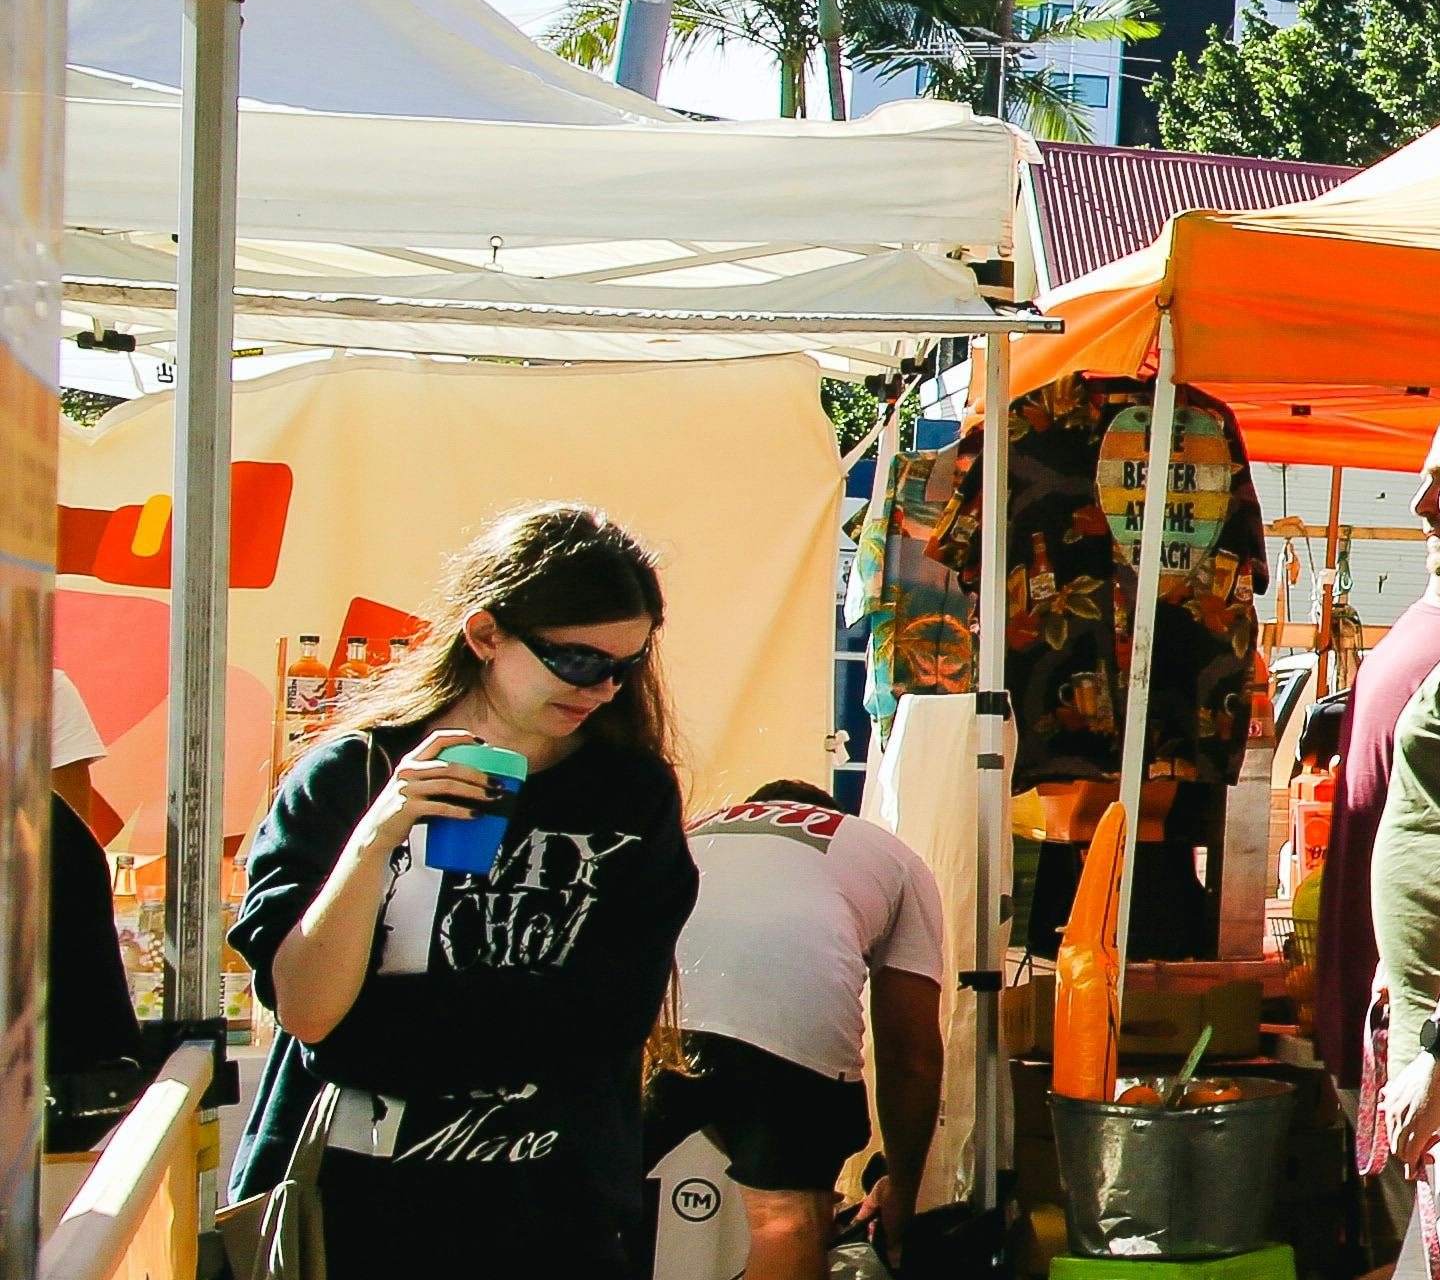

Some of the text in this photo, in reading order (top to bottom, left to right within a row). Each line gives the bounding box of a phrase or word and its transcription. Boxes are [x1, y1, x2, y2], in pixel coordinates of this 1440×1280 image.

[1123, 461, 1197, 492] BETER
[1132, 539, 1192, 570] BACH
[679, 1191, 713, 1211] TM
